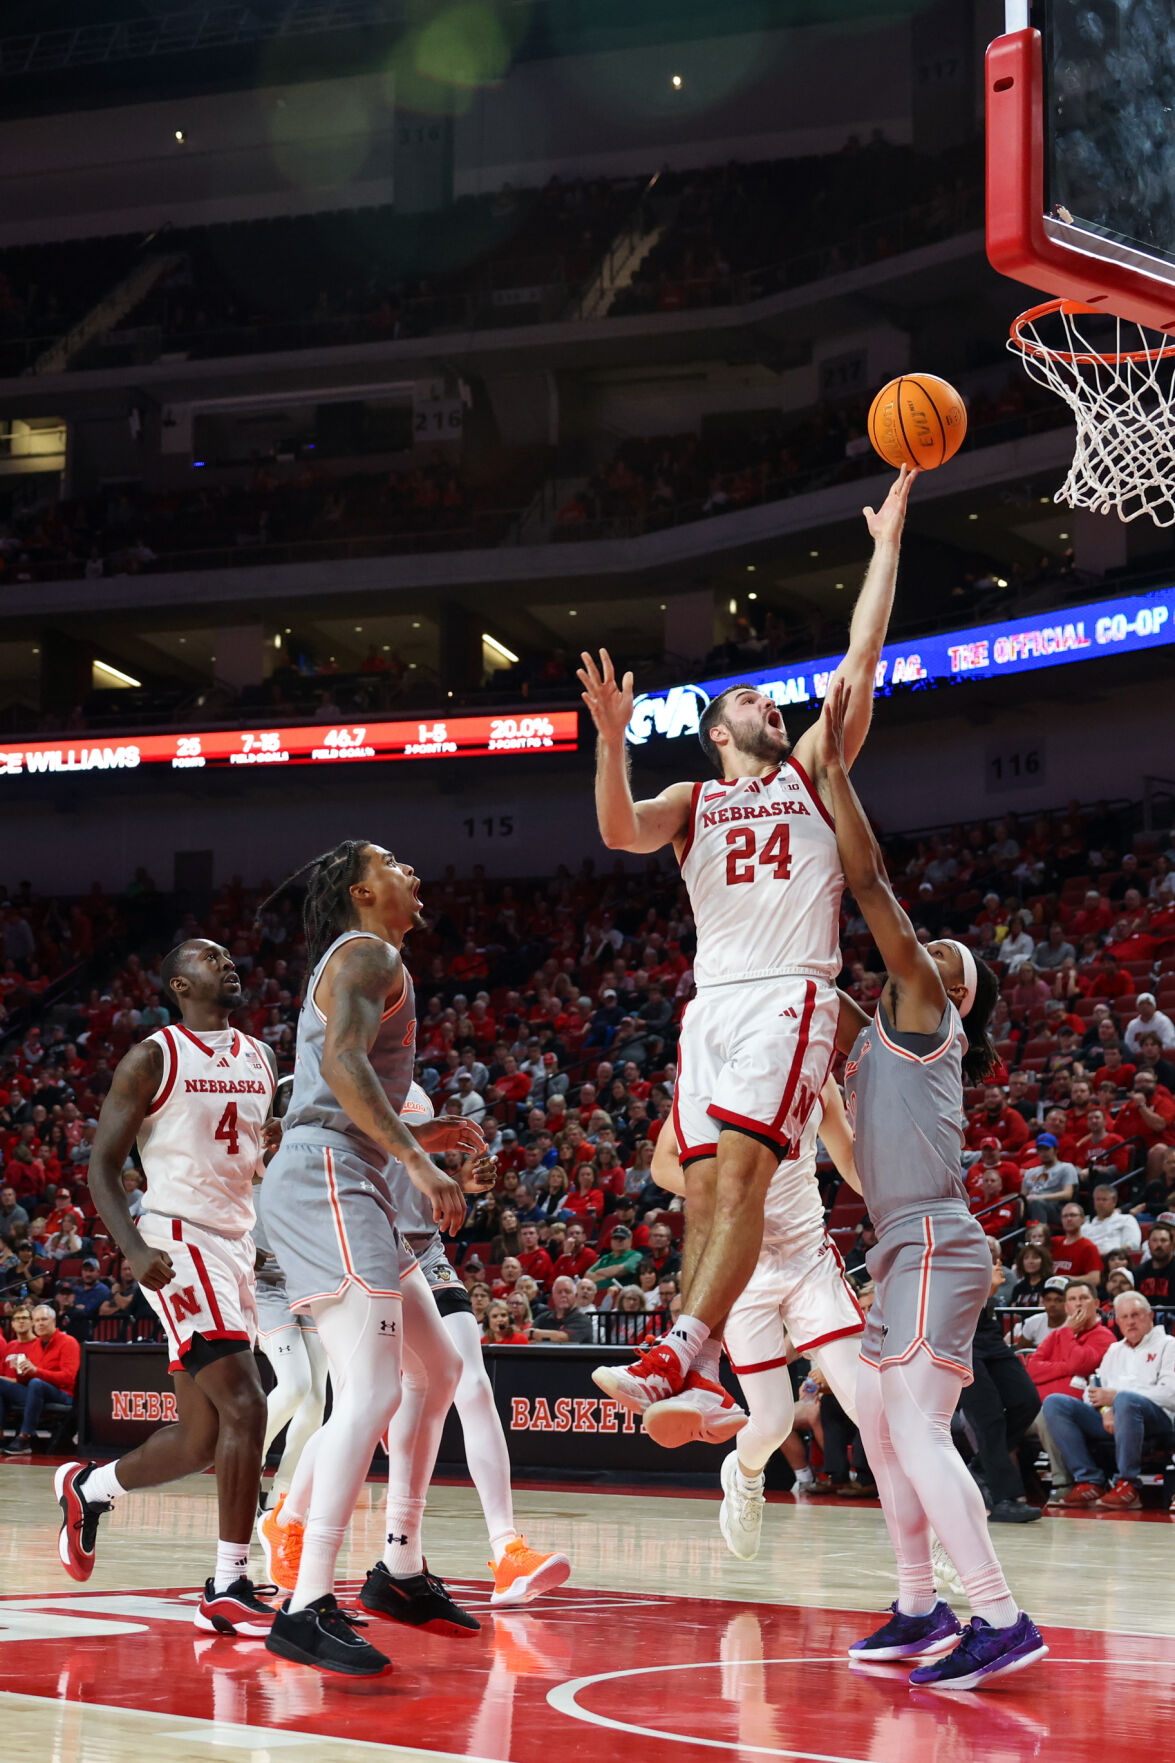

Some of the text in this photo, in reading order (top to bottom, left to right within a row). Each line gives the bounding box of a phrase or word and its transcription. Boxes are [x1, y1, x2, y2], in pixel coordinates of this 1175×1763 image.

[415, 409, 461, 432] 216
[948, 605, 1169, 672] THE OFFICIAL CO-OP
[324, 728, 366, 747] 46.7
[418, 723, 448, 743] 1-5
[490, 717, 554, 739] 20.0%
[176, 737, 202, 756] 25
[241, 733, 280, 753] 7-15
[25, 745, 141, 773] WILLIAMS
[991, 750, 1040, 779] 116
[463, 816, 513, 838] 115
[702, 801, 811, 828] NEBRASKA
[726, 823, 792, 886] 24
[184, 1079, 266, 1095] NEBRASKA
[214, 1102, 240, 1155] 4
[169, 1285, 202, 1323] N
[111, 1391, 180, 1421] NEBR
[510, 1397, 651, 1434] BASKET
